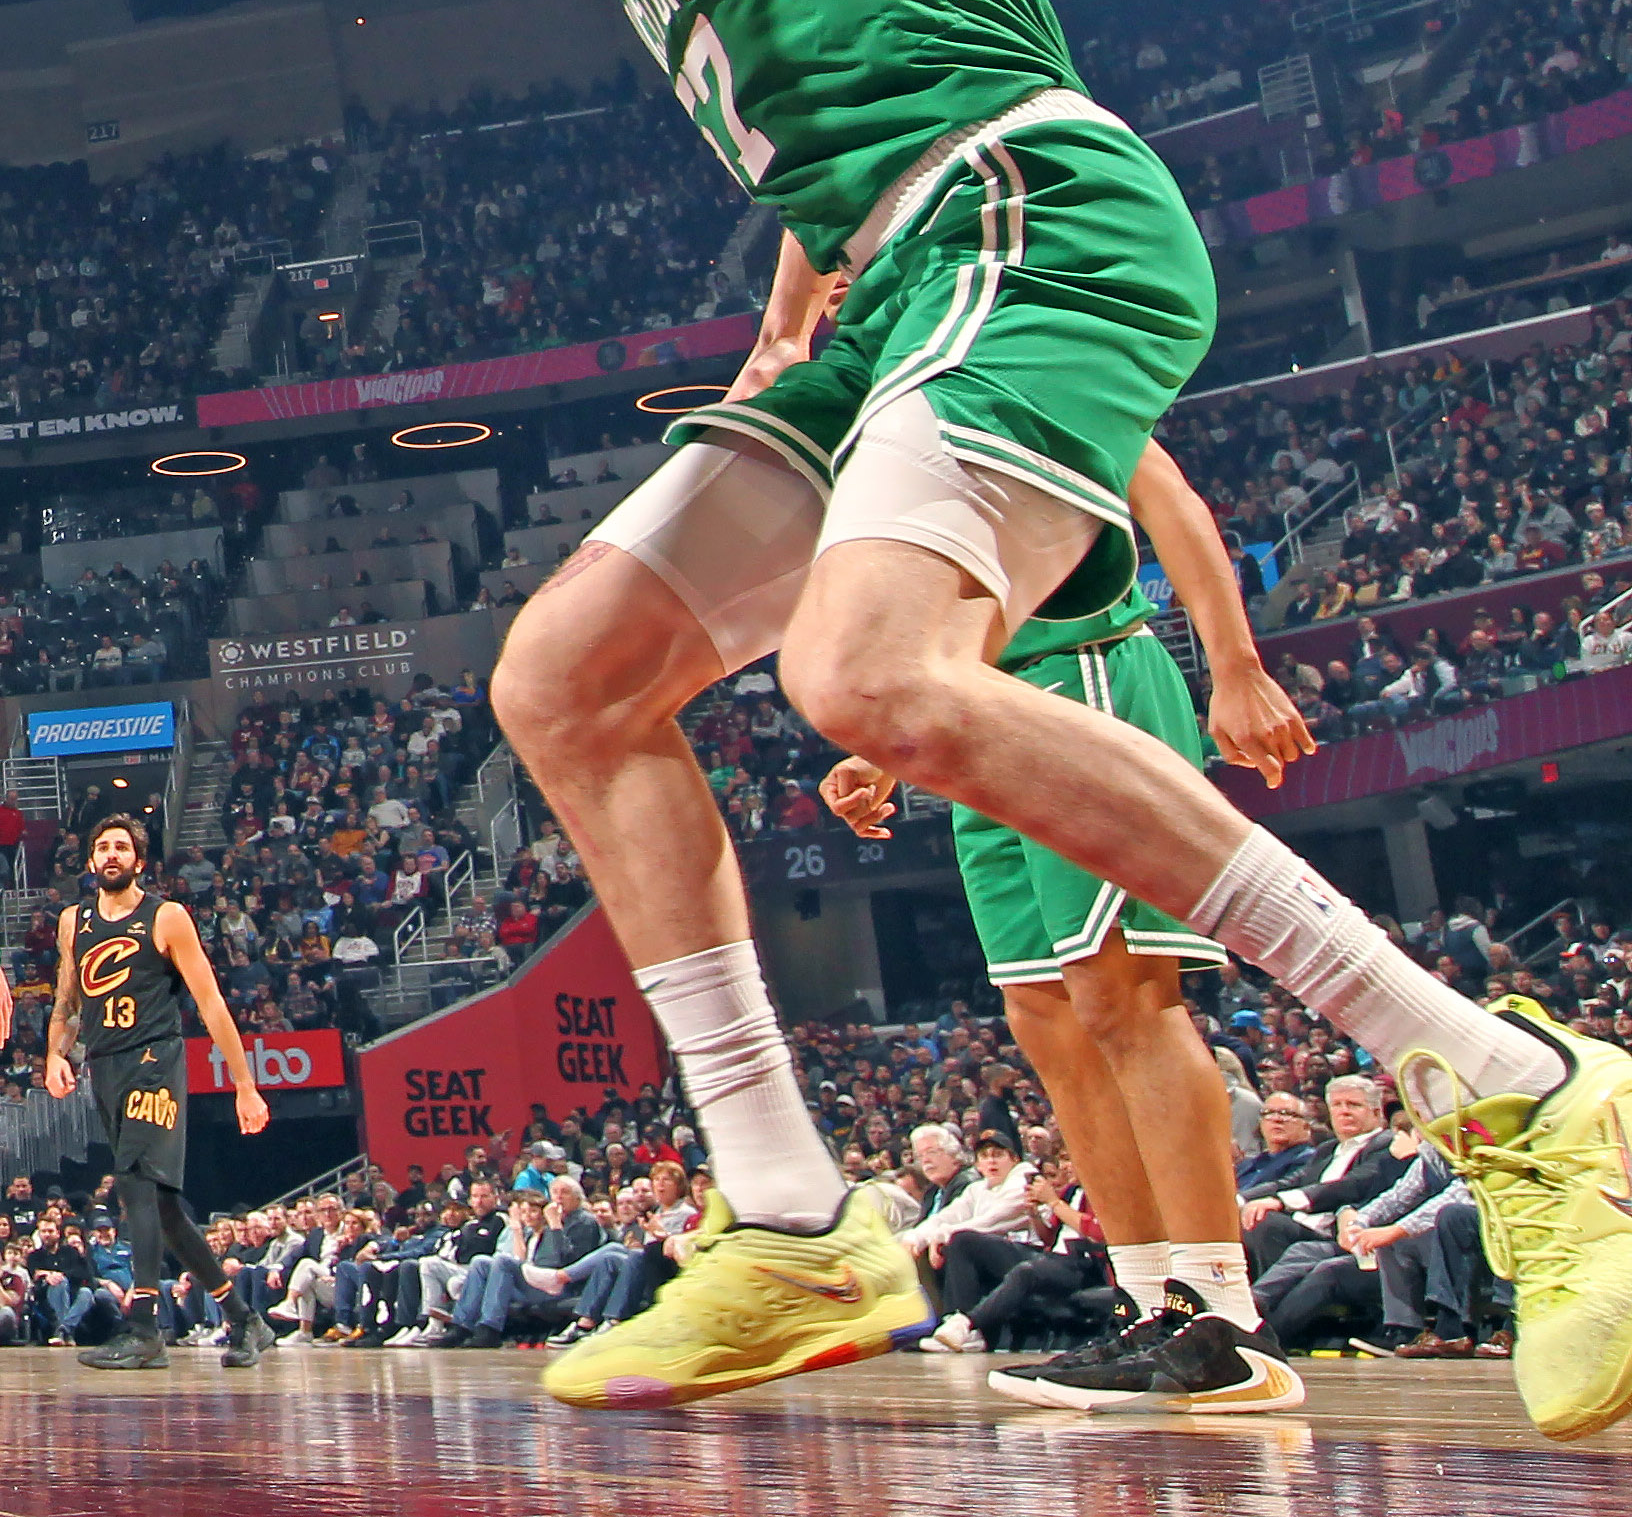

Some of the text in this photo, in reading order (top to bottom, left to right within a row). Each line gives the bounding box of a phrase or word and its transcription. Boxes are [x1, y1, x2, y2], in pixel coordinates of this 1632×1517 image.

[37, 416, 82, 438] EM
[84, 405, 185, 435] KNOW.
[248, 629, 408, 661] WESTFIELD
[225, 662, 411, 690] CHAMPIONS CLUB
[32, 714, 166, 745] PROGRESSIVE
[785, 843, 827, 880] 26
[102, 994, 137, 1030] 13
[556, 992, 617, 1038] SEAT
[556, 1041, 630, 1087] GEEK
[405, 1067, 487, 1103] SEAT
[124, 1086, 179, 1131] CAVS
[404, 1104, 495, 1138] GEEK
